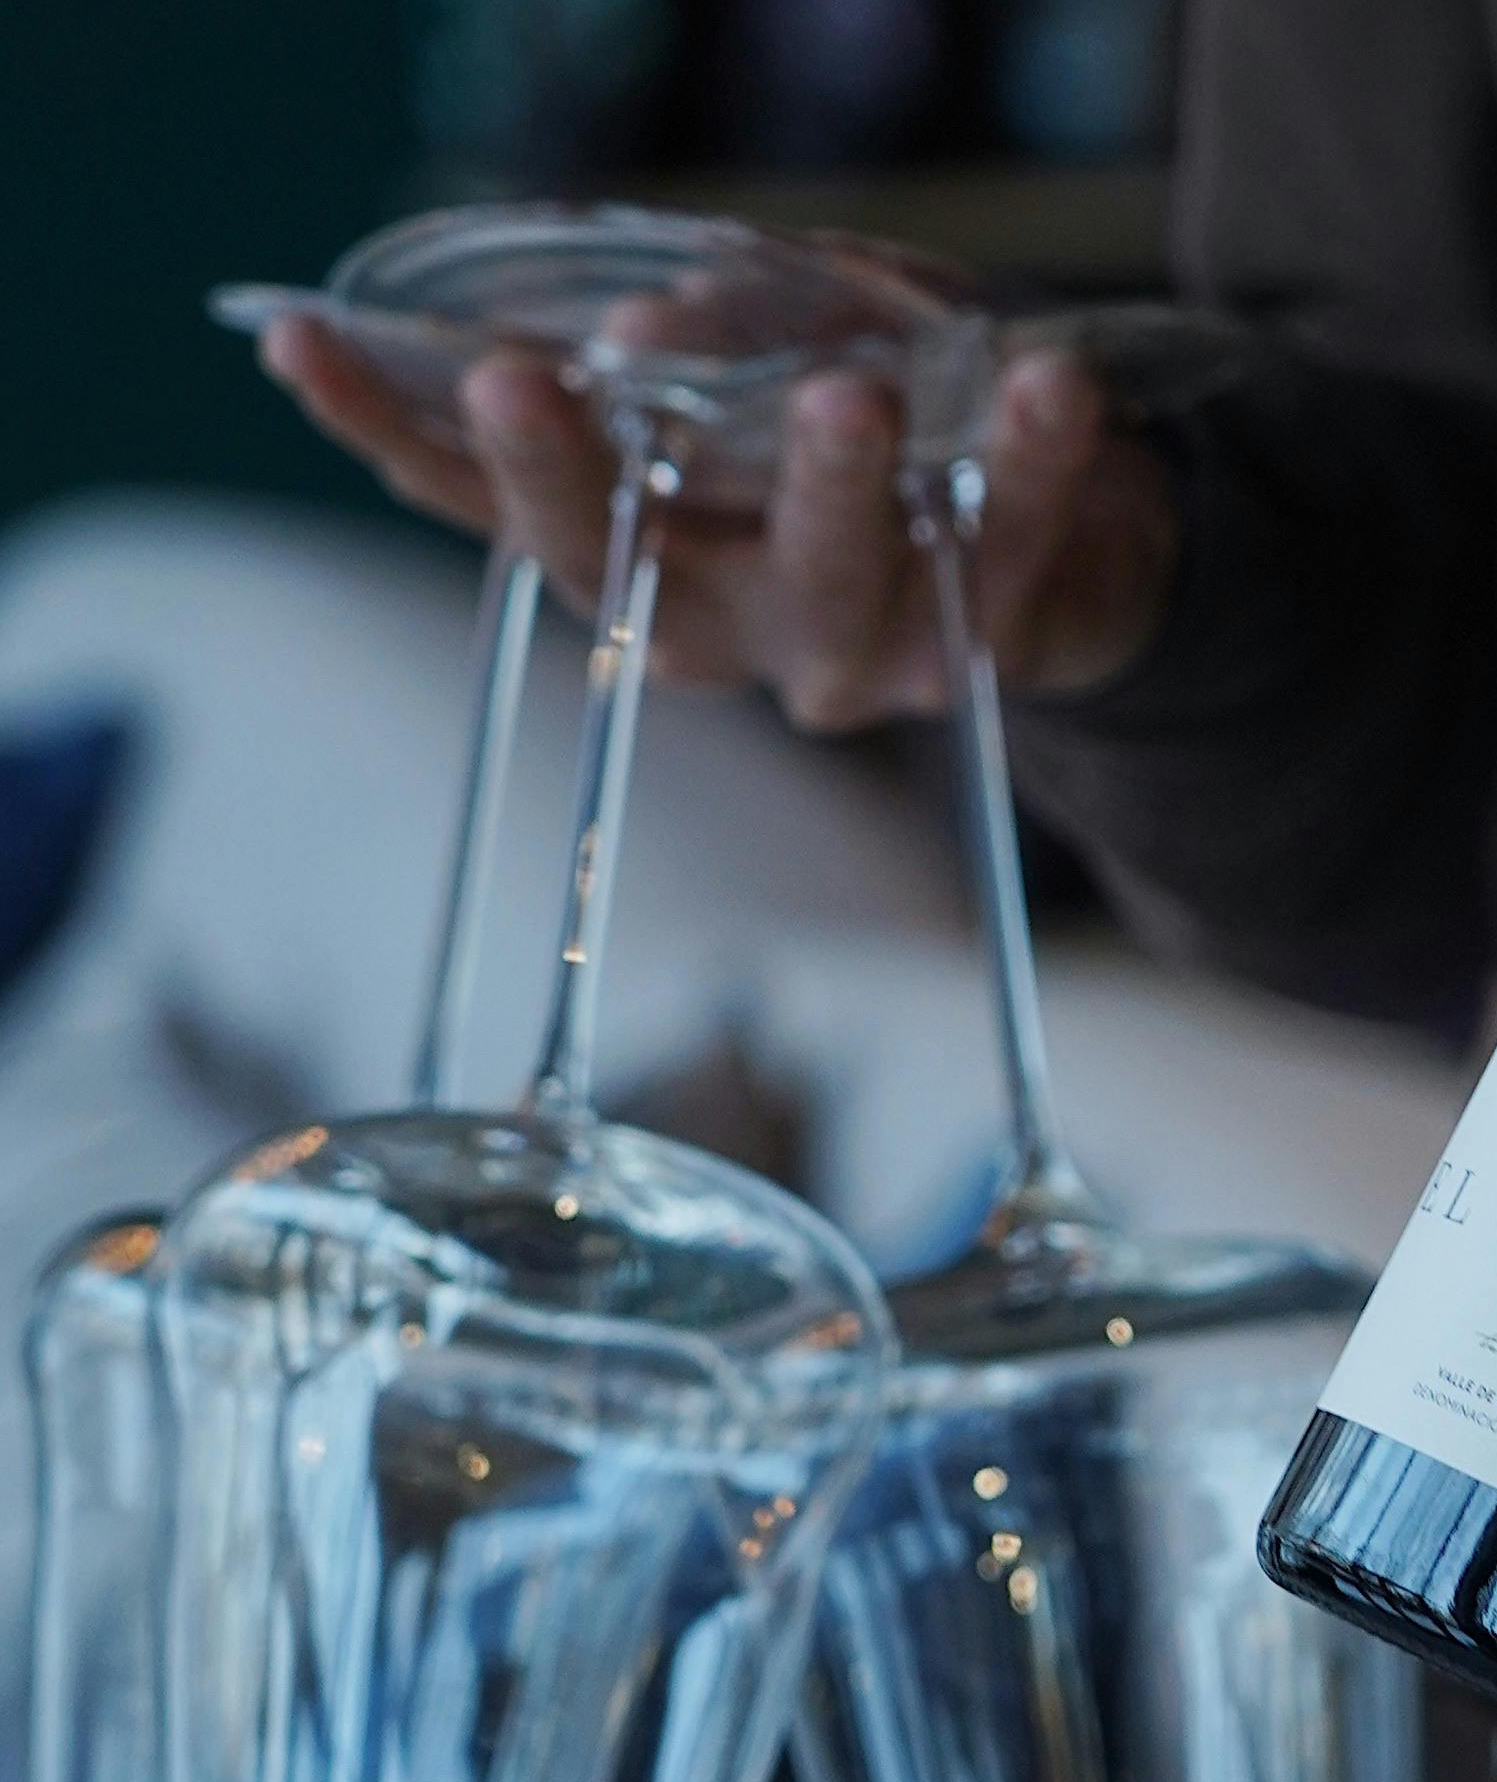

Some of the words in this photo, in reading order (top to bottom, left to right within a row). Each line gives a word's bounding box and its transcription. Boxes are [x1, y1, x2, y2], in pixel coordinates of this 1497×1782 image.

[1420, 1160, 1475, 1225] EL
[1438, 1365, 1476, 1394] VALLE
[1476, 1384, 1497, 1404] DE
